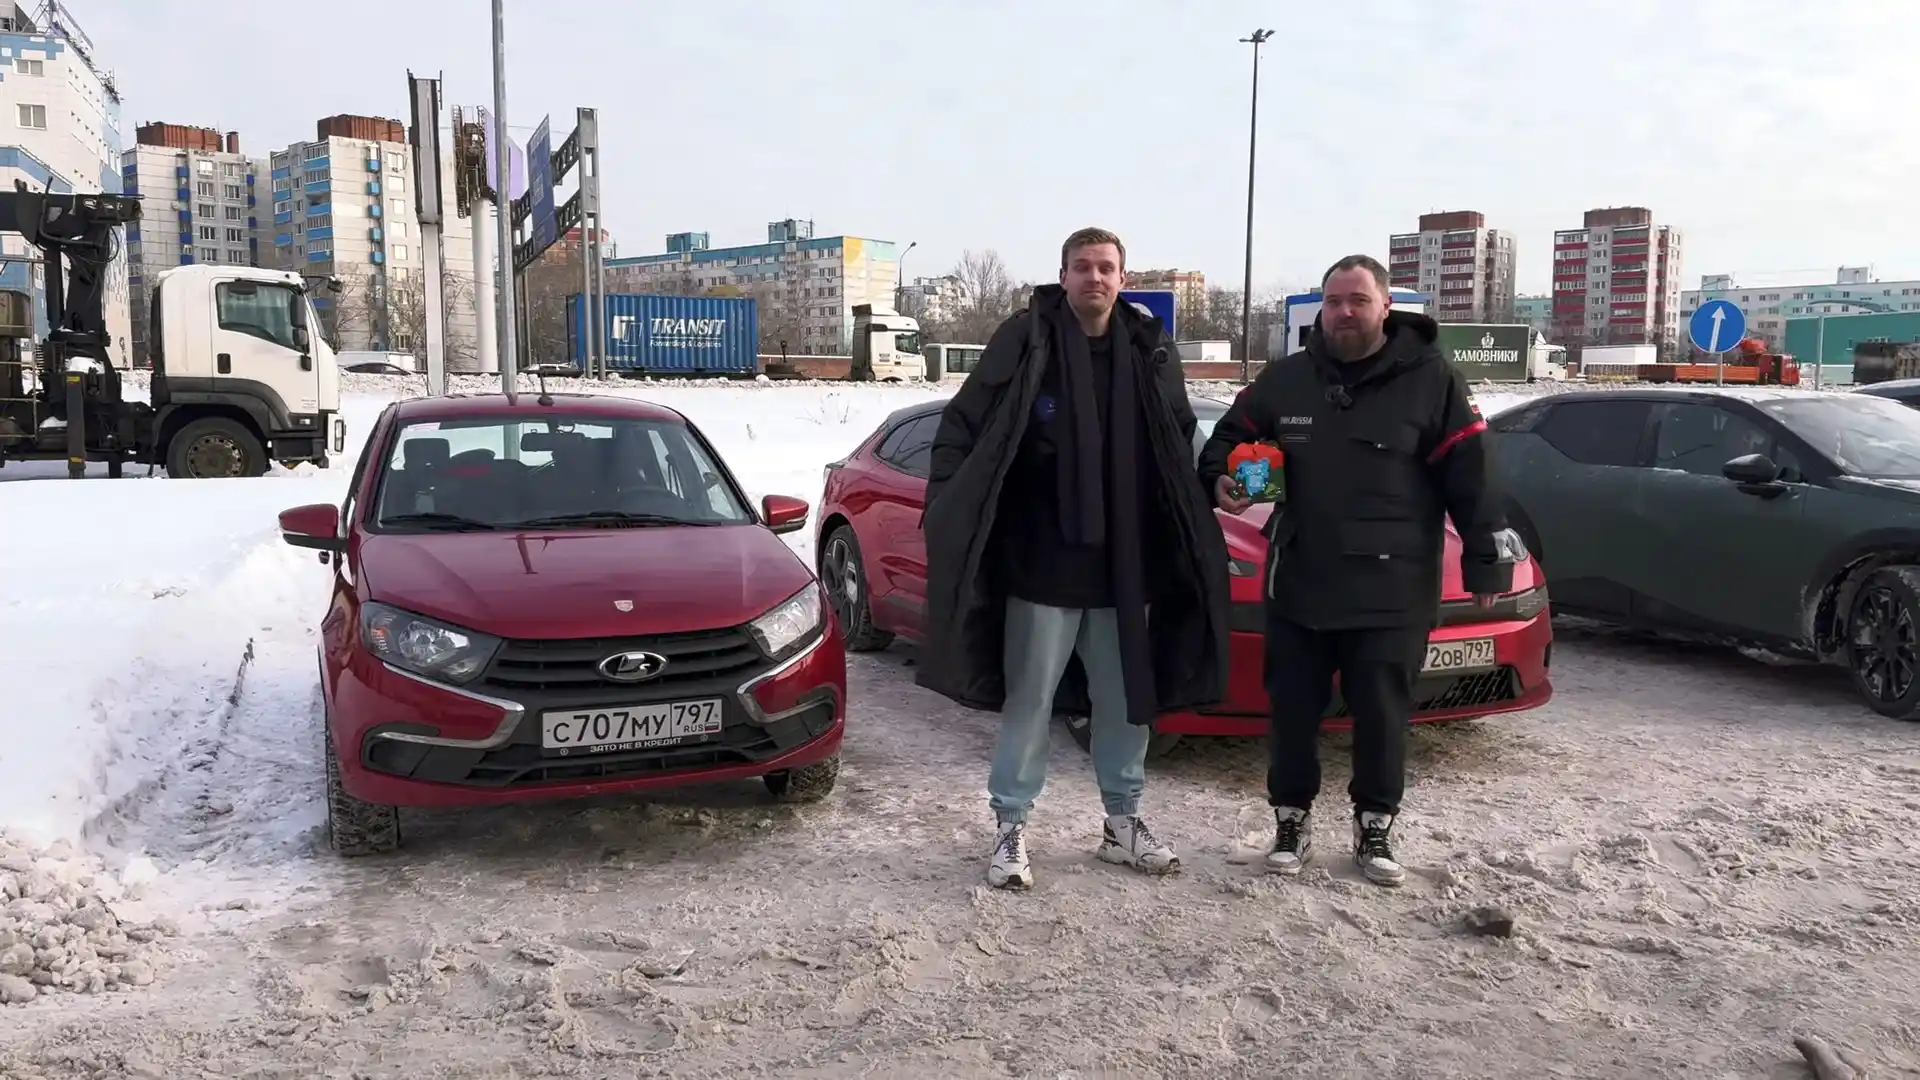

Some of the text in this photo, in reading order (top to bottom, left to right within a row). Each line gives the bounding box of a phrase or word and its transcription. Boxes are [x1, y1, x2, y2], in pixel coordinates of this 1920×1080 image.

[651, 318, 726, 335] TRANSIT
[1453, 349, 1519, 362] ХАМОВНИКИ
[1466, 641, 1491, 659] 797
[553, 702, 715, 743] С707МУ 797
[683, 724, 704, 733] RUS
[590, 737, 682, 753] ЗАТО НЕ В КРЕДИТ
